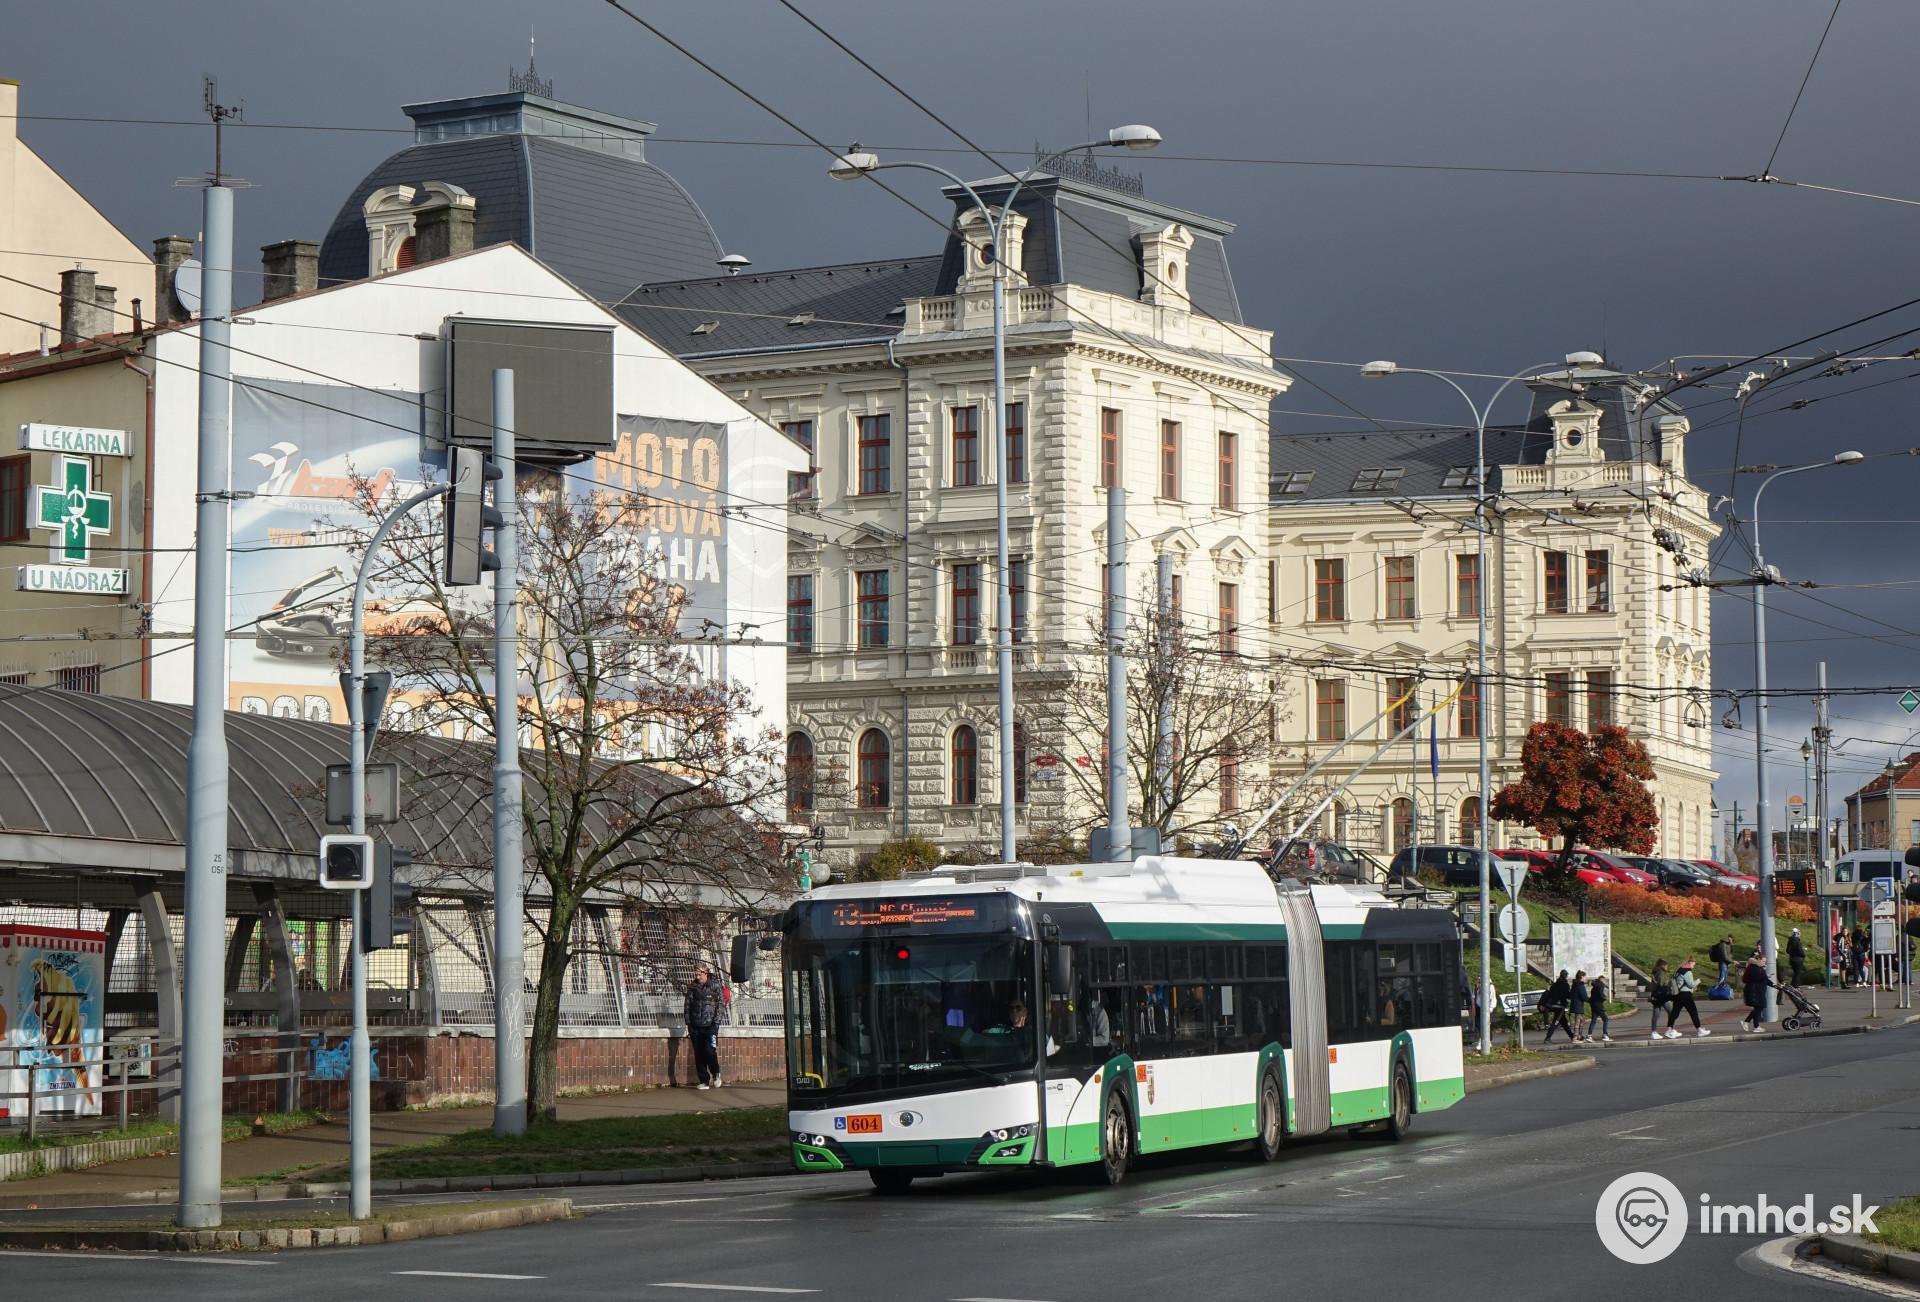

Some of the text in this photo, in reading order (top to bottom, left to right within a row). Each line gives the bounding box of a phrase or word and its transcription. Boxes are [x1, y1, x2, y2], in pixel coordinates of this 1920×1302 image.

[43, 428, 121, 453] LEKÁRNA
[595, 431, 720, 493] MOTO
[31, 567, 127, 592] U NÁDRAŽÍ
[851, 1117, 878, 1131] 604
